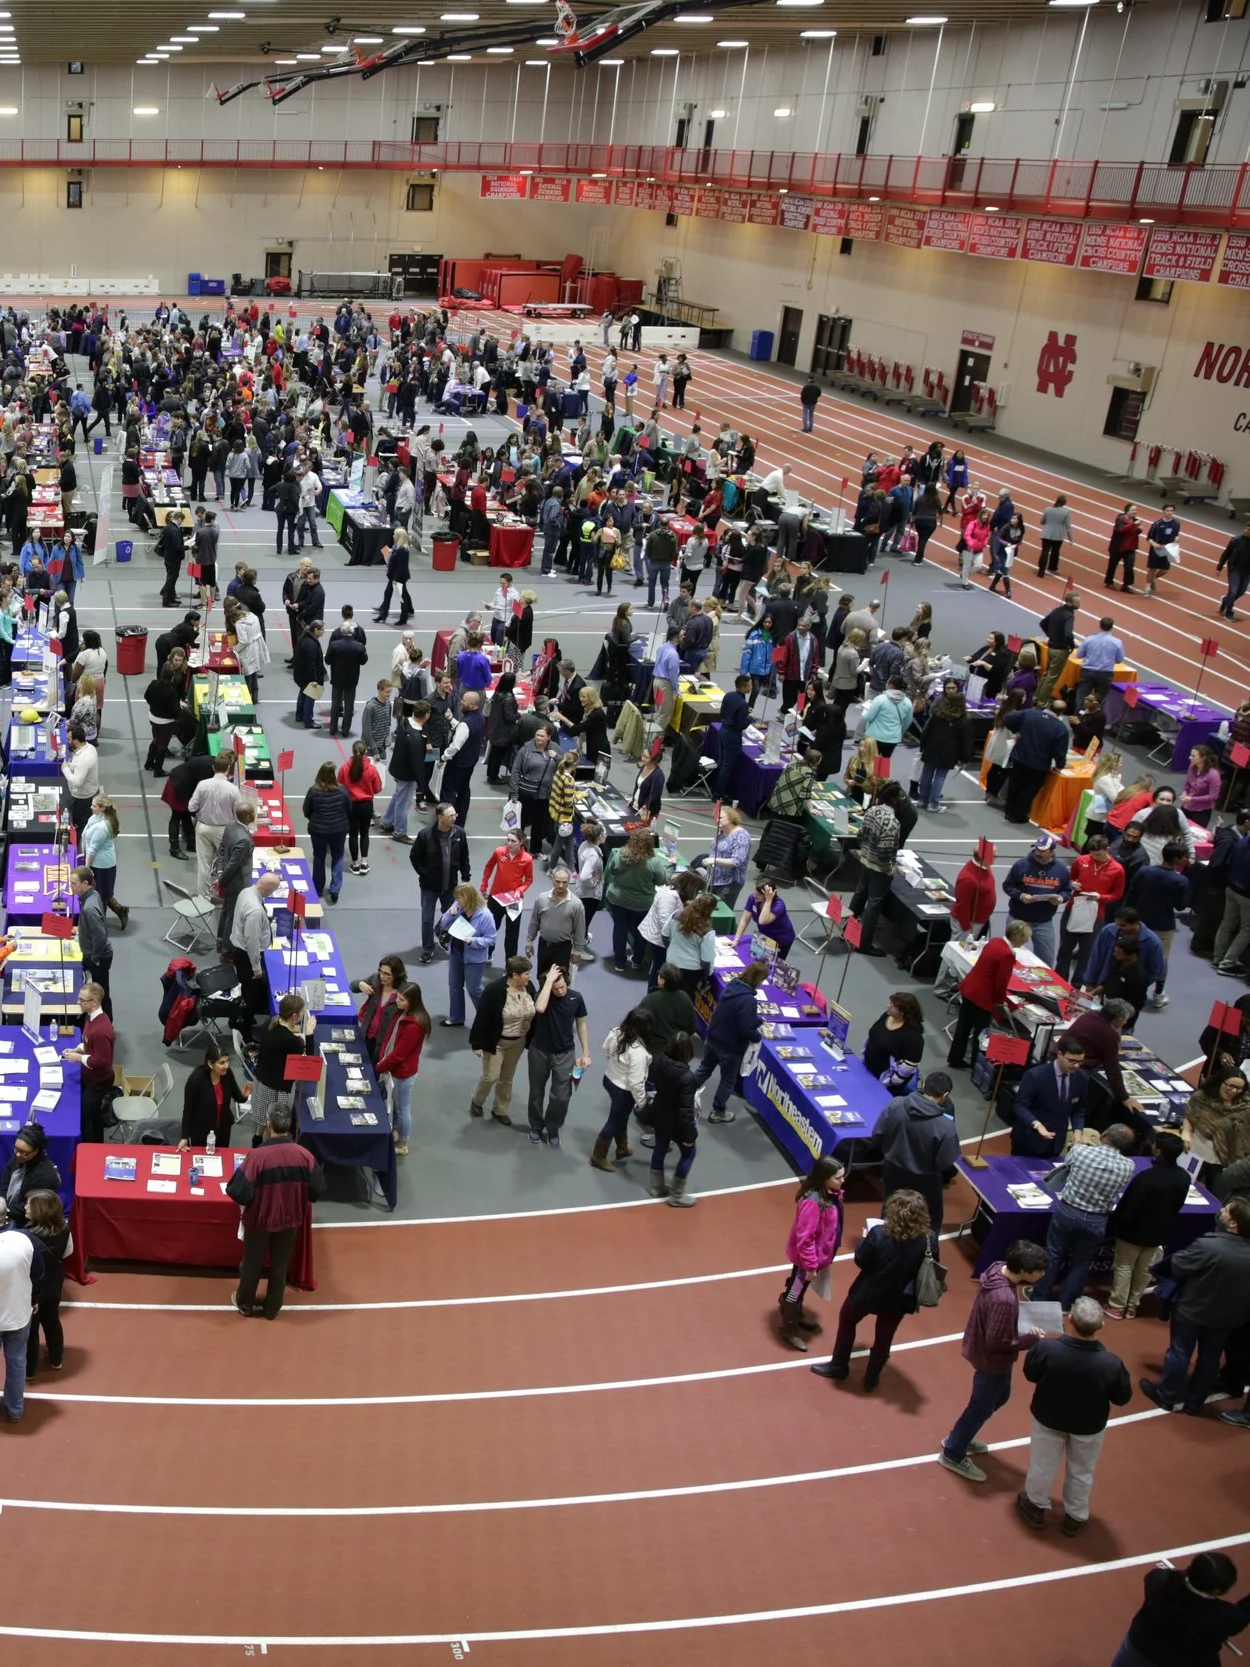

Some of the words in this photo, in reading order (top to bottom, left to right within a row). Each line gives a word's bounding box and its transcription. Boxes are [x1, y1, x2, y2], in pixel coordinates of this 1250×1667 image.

[1041, 221, 1060, 232] NCAA
[1105, 226, 1125, 237] NCAA
[1046, 232, 1077, 244] NATIONAL
[1108, 237, 1143, 250] NATIONAL
[1170, 231, 1194, 243] NCAA
[1228, 236, 1247, 247] 1998
[976, 244, 1009, 256] CHAMPIONS
[1026, 240, 1048, 251] TRACK
[1053, 242, 1074, 254] FIELD
[1083, 246, 1107, 257] CROSS
[1106, 248, 1142, 261] COUNTRY
[1150, 242, 1173, 253] MEN'S
[1174, 243, 1217, 257] NATIONAL
[1224, 247, 1250, 260] MEN'S
[1028, 249, 1067, 264] CHAMPIONS
[1150, 253, 1179, 266] TRACK
[1185, 257, 1212, 269] FIELD
[1090, 258, 1130, 272] CHAMPIONS
[1220, 260, 1250, 274] CROSS
[1153, 266, 1201, 281] CHAMPIONS
[768, 1074, 824, 1155] Northeastern
[244, 1644, 255, 1656] 75
[450, 1642, 464, 1660] 300
